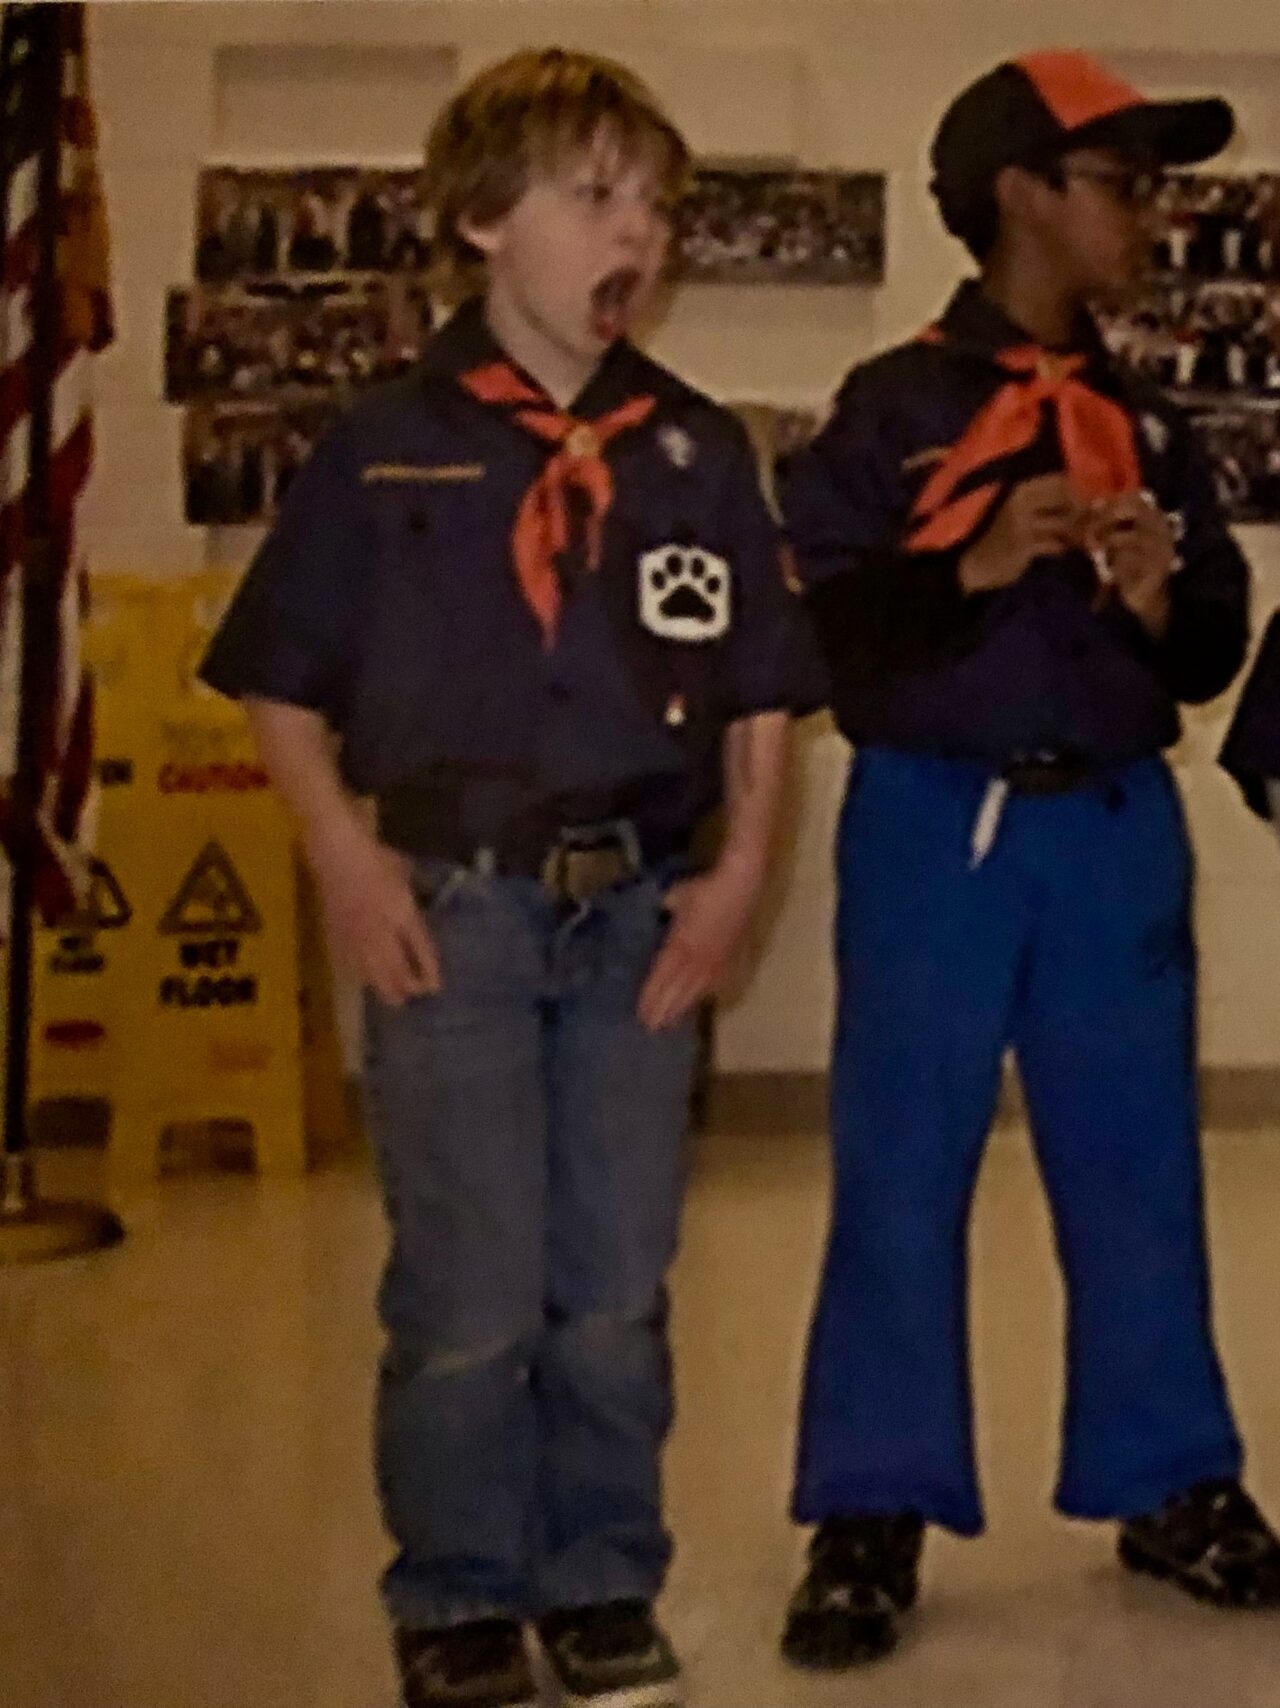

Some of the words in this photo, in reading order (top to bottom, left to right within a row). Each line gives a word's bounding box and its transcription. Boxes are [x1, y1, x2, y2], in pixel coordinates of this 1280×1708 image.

[157, 762, 269, 794] CAUTION
[180, 938, 239, 968] WET
[159, 975, 257, 1006] FLOOR
